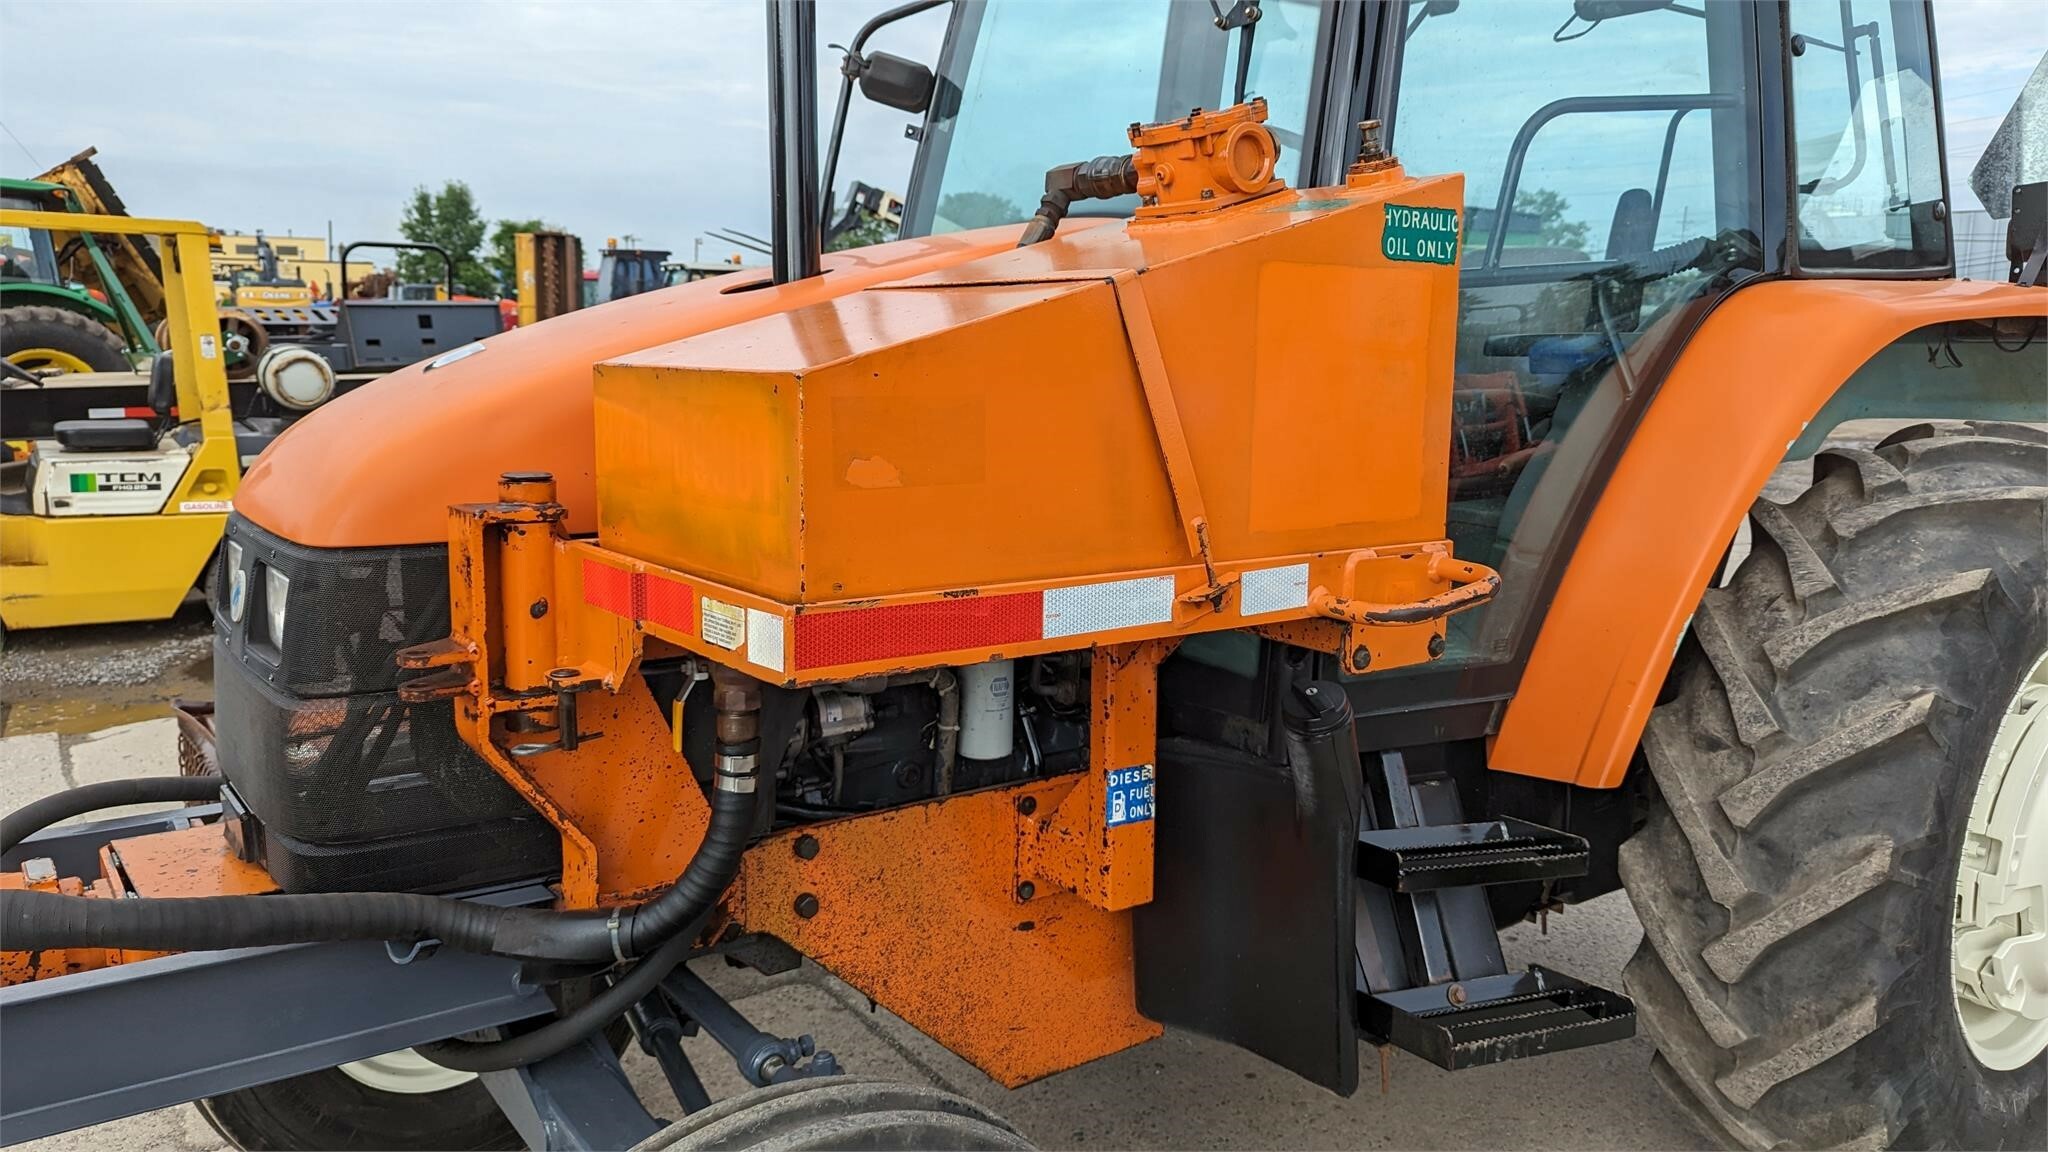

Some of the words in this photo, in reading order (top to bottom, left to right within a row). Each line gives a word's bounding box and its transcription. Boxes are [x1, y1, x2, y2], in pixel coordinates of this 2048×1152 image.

[1386, 208, 1459, 232] HYDRAULIC
[1387, 236, 1410, 256] OIL
[1417, 239, 1454, 259] ONLY
[97, 472, 161, 483] TCM
[1130, 784, 1154, 801] FUEL
[1130, 802, 1155, 818] ONLY
